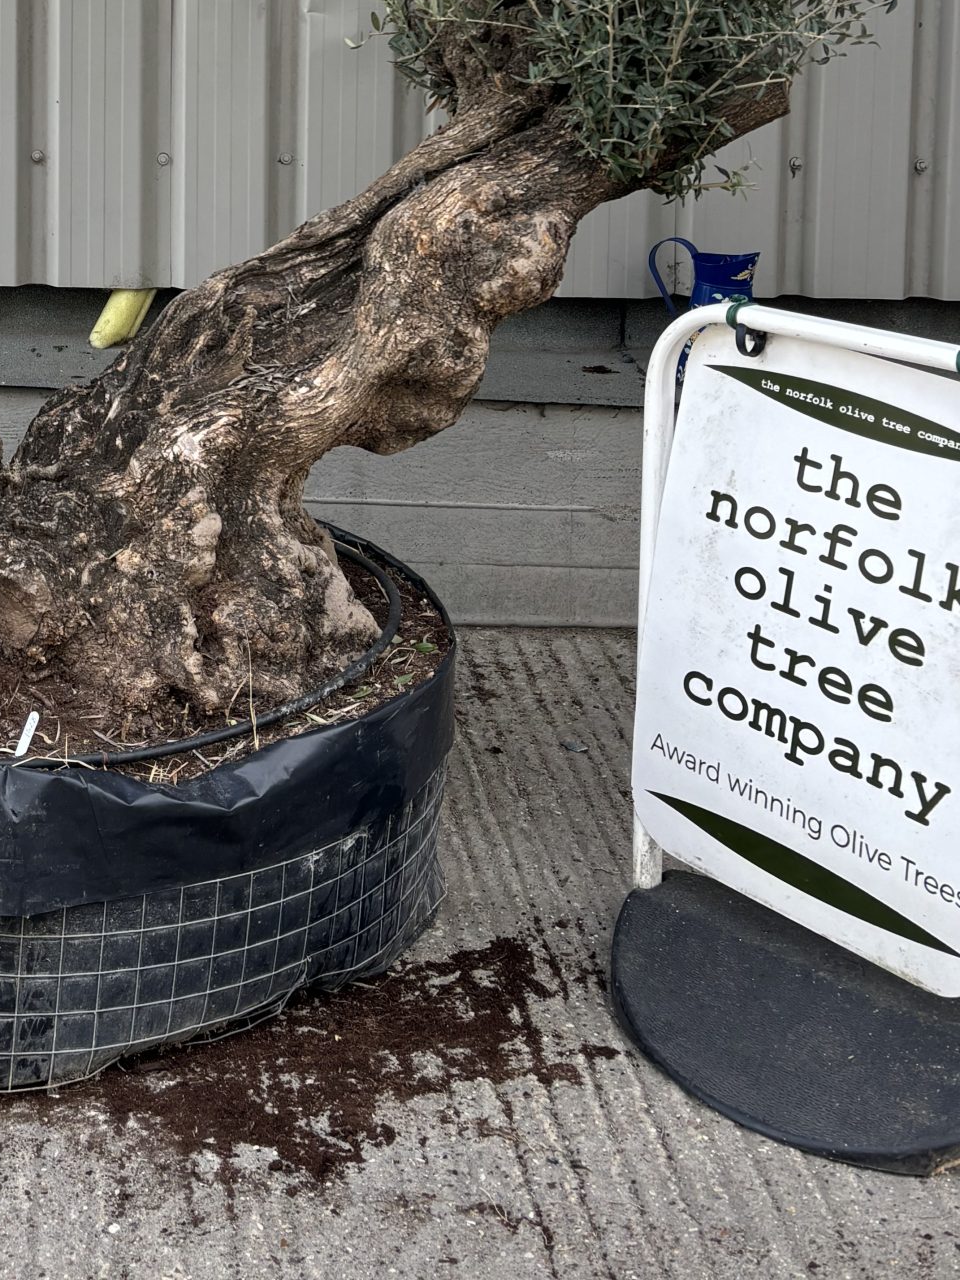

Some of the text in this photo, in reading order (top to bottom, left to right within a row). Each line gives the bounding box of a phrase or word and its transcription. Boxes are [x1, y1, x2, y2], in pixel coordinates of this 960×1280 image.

[761, 379, 781, 393] the
[785, 387, 834, 410] norfolk
[839, 405, 875, 423] olive
[882, 417, 911, 434] tree
[794, 447, 902, 521] the
[734, 566, 926, 667] olive
[746, 624, 894, 722] tree
[683, 670, 952, 827] company
[650, 733, 721, 785] Award
[727, 773, 822, 841] winning
[830, 824, 892, 871] Olive
